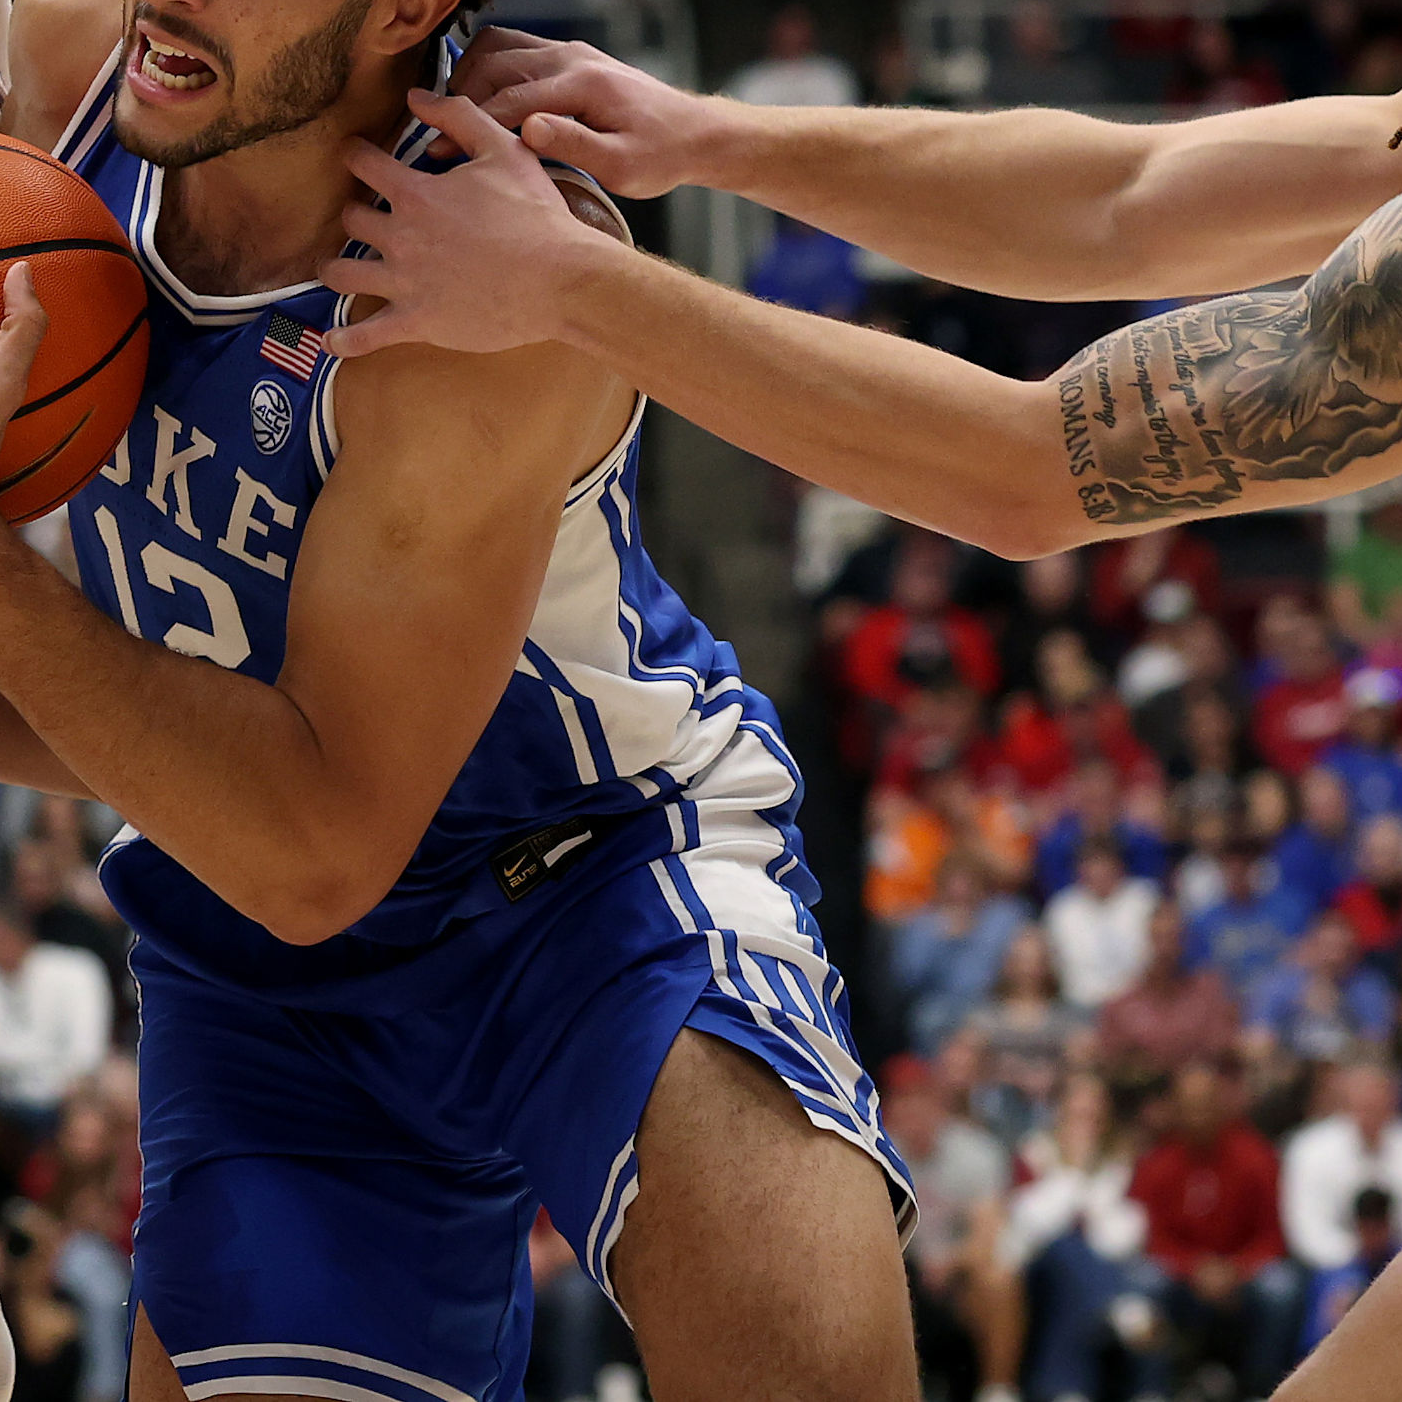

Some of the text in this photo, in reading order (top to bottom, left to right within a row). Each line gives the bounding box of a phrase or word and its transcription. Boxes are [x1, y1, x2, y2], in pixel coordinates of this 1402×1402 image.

[255, 404, 290, 433] ACC
[1059, 373, 1096, 477] ROMANS
[1093, 366, 1116, 429] coming
[99, 404, 297, 581] KE
[94, 505, 251, 670] 12
